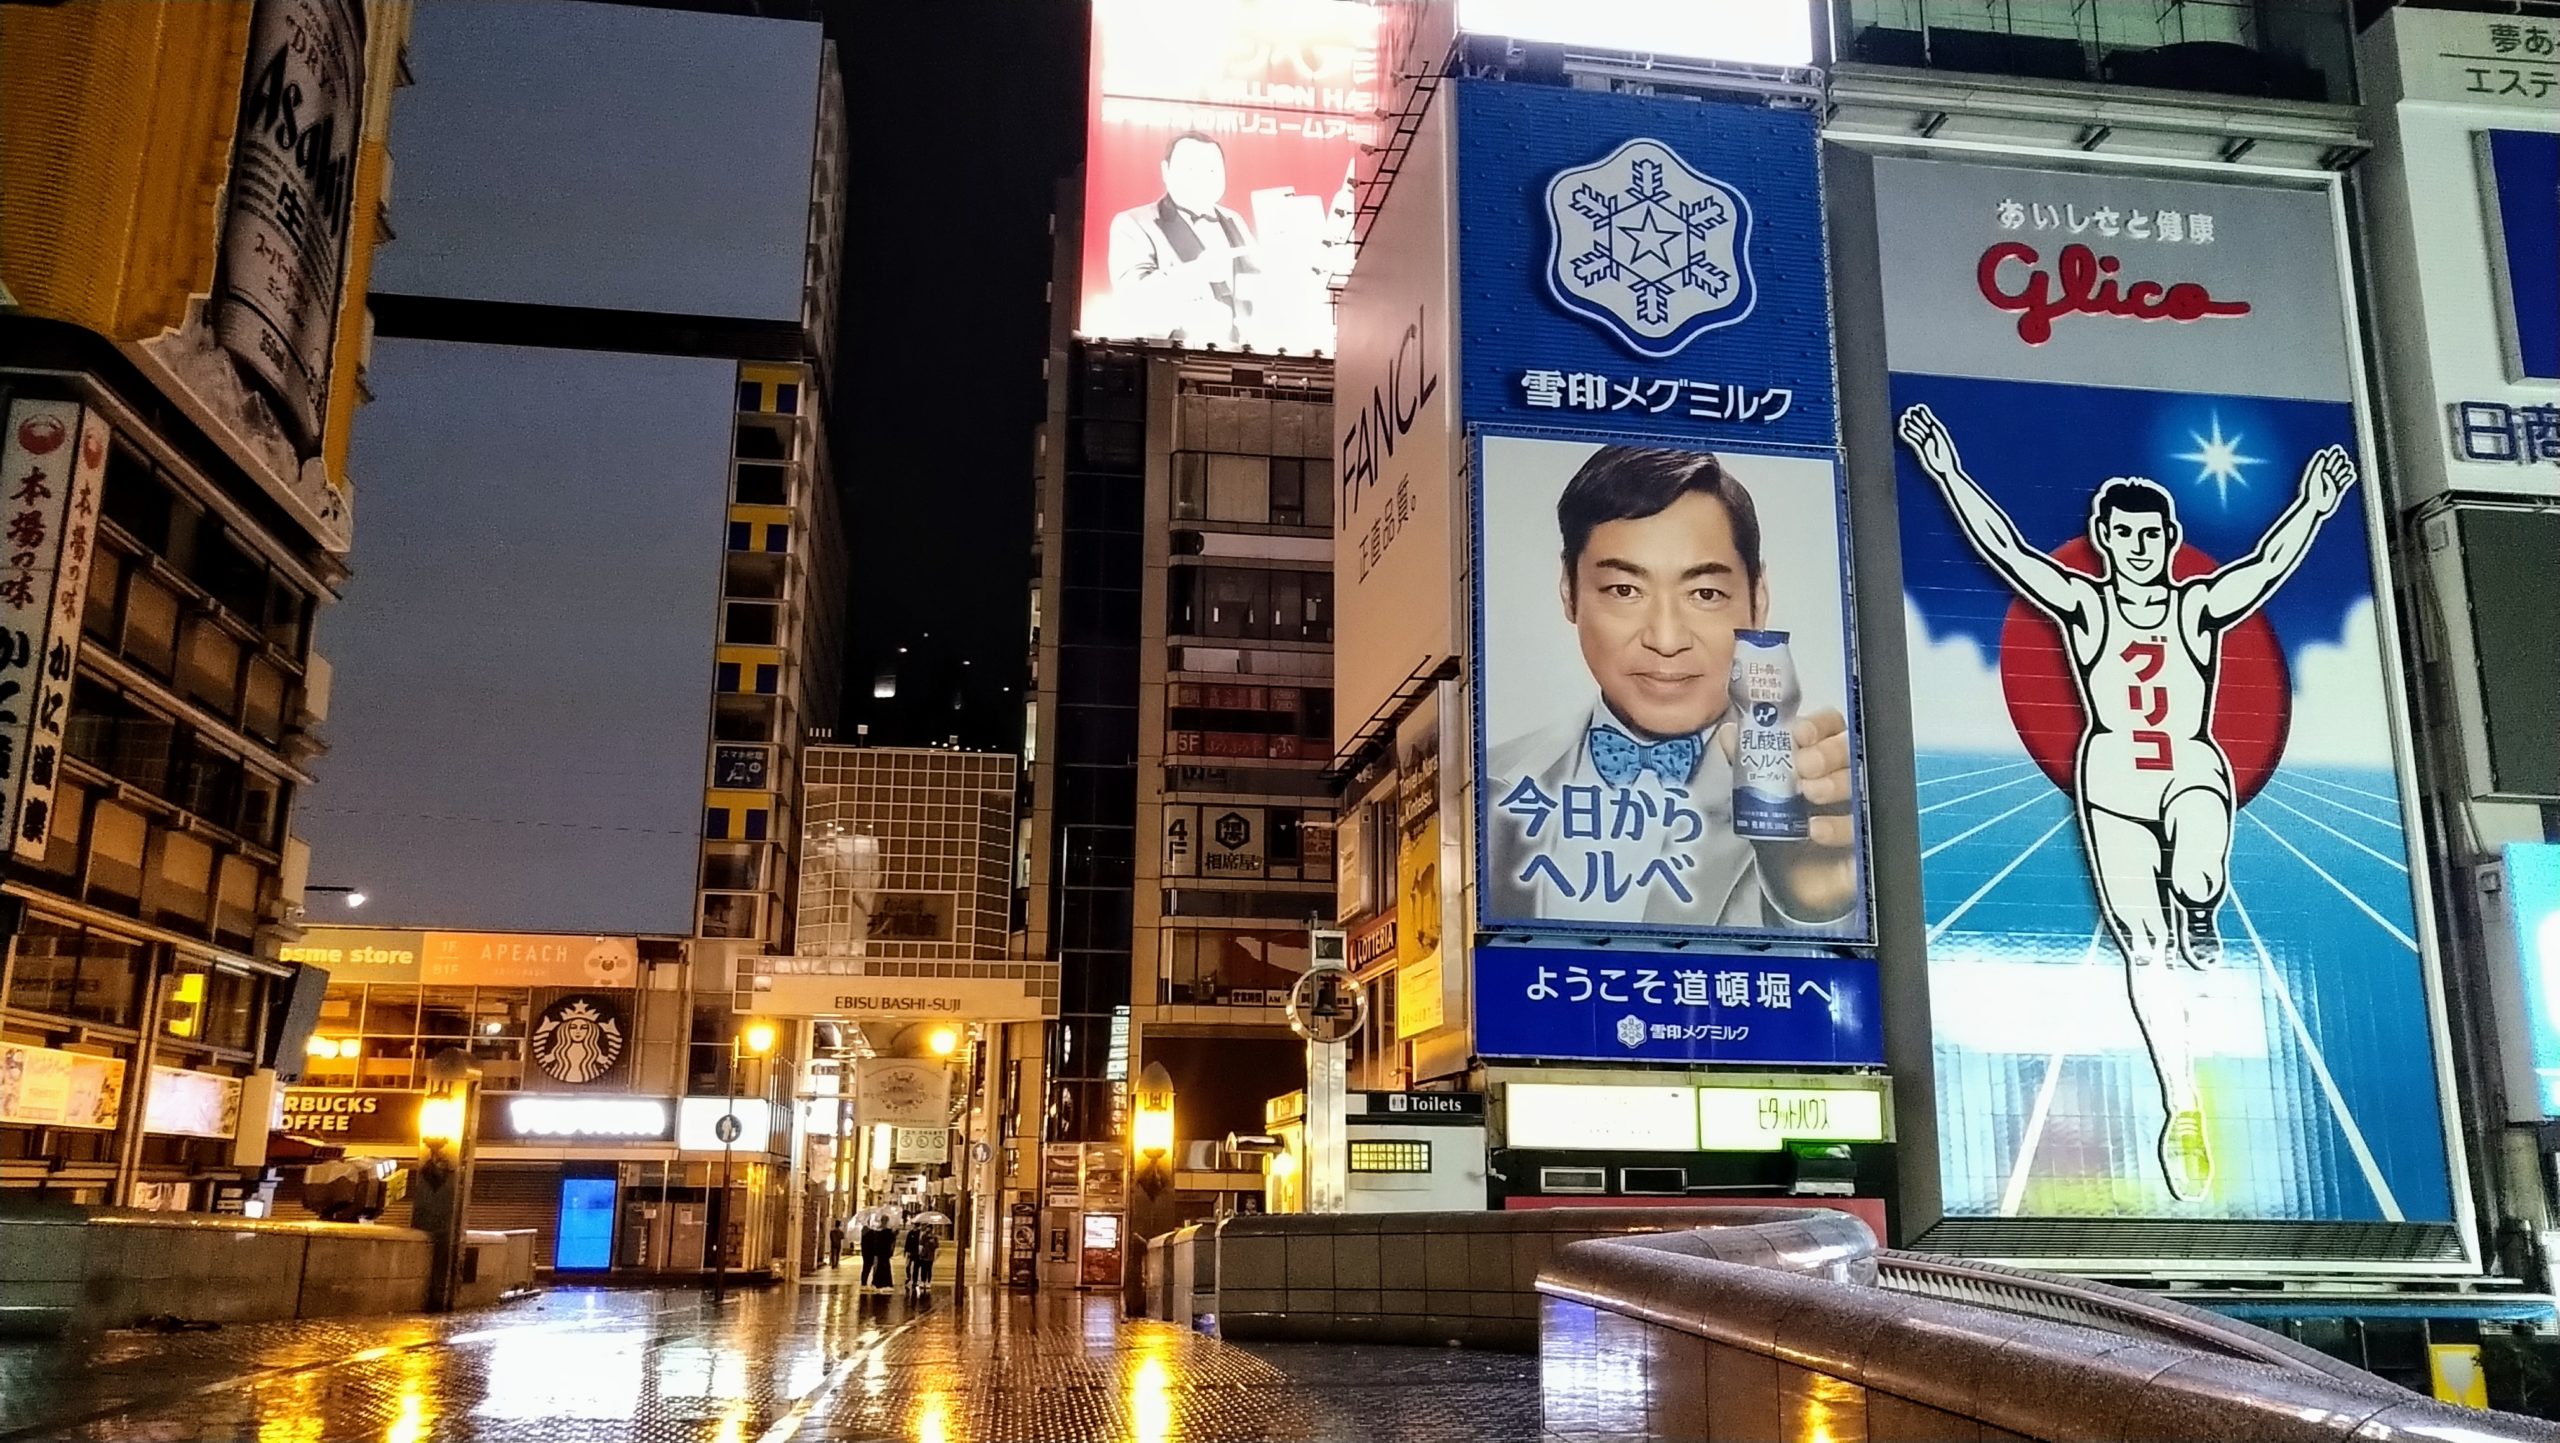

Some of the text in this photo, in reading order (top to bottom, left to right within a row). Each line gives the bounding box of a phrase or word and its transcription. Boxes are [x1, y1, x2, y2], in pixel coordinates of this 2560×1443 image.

[248, 42, 346, 238] Asahi
[1977, 242, 2251, 346] Glico
[1521, 369, 1793, 422] 雪印メグミルク
[1342, 304, 1437, 531] FANCL
[2120, 635, 2174, 771] グリコ
[1177, 734, 1199, 752] 5F
[1741, 730, 1792, 752] 乳酸菌
[1748, 771, 1788, 783] ヨーグルト
[1498, 775, 1703, 843] 今日から
[1519, 850, 1695, 903] ヘルベ
[350, 945, 413, 965] store
[441, 940, 568, 963] 1F APEACH
[1357, 923, 1394, 964] LOTTERIA
[1526, 966, 1832, 1010] ようこそ道頓堀へ
[834, 996, 961, 1012] EBISU BASHI-SUJI
[1650, 1022, 1749, 1042] 雪印メグミルク
[283, 1097, 377, 1113] RBUCKS
[1410, 1096, 1462, 1112] Toilets
[1758, 1096, 1831, 1130] ピタットハウス
[280, 1114, 349, 1131] OFFEE
